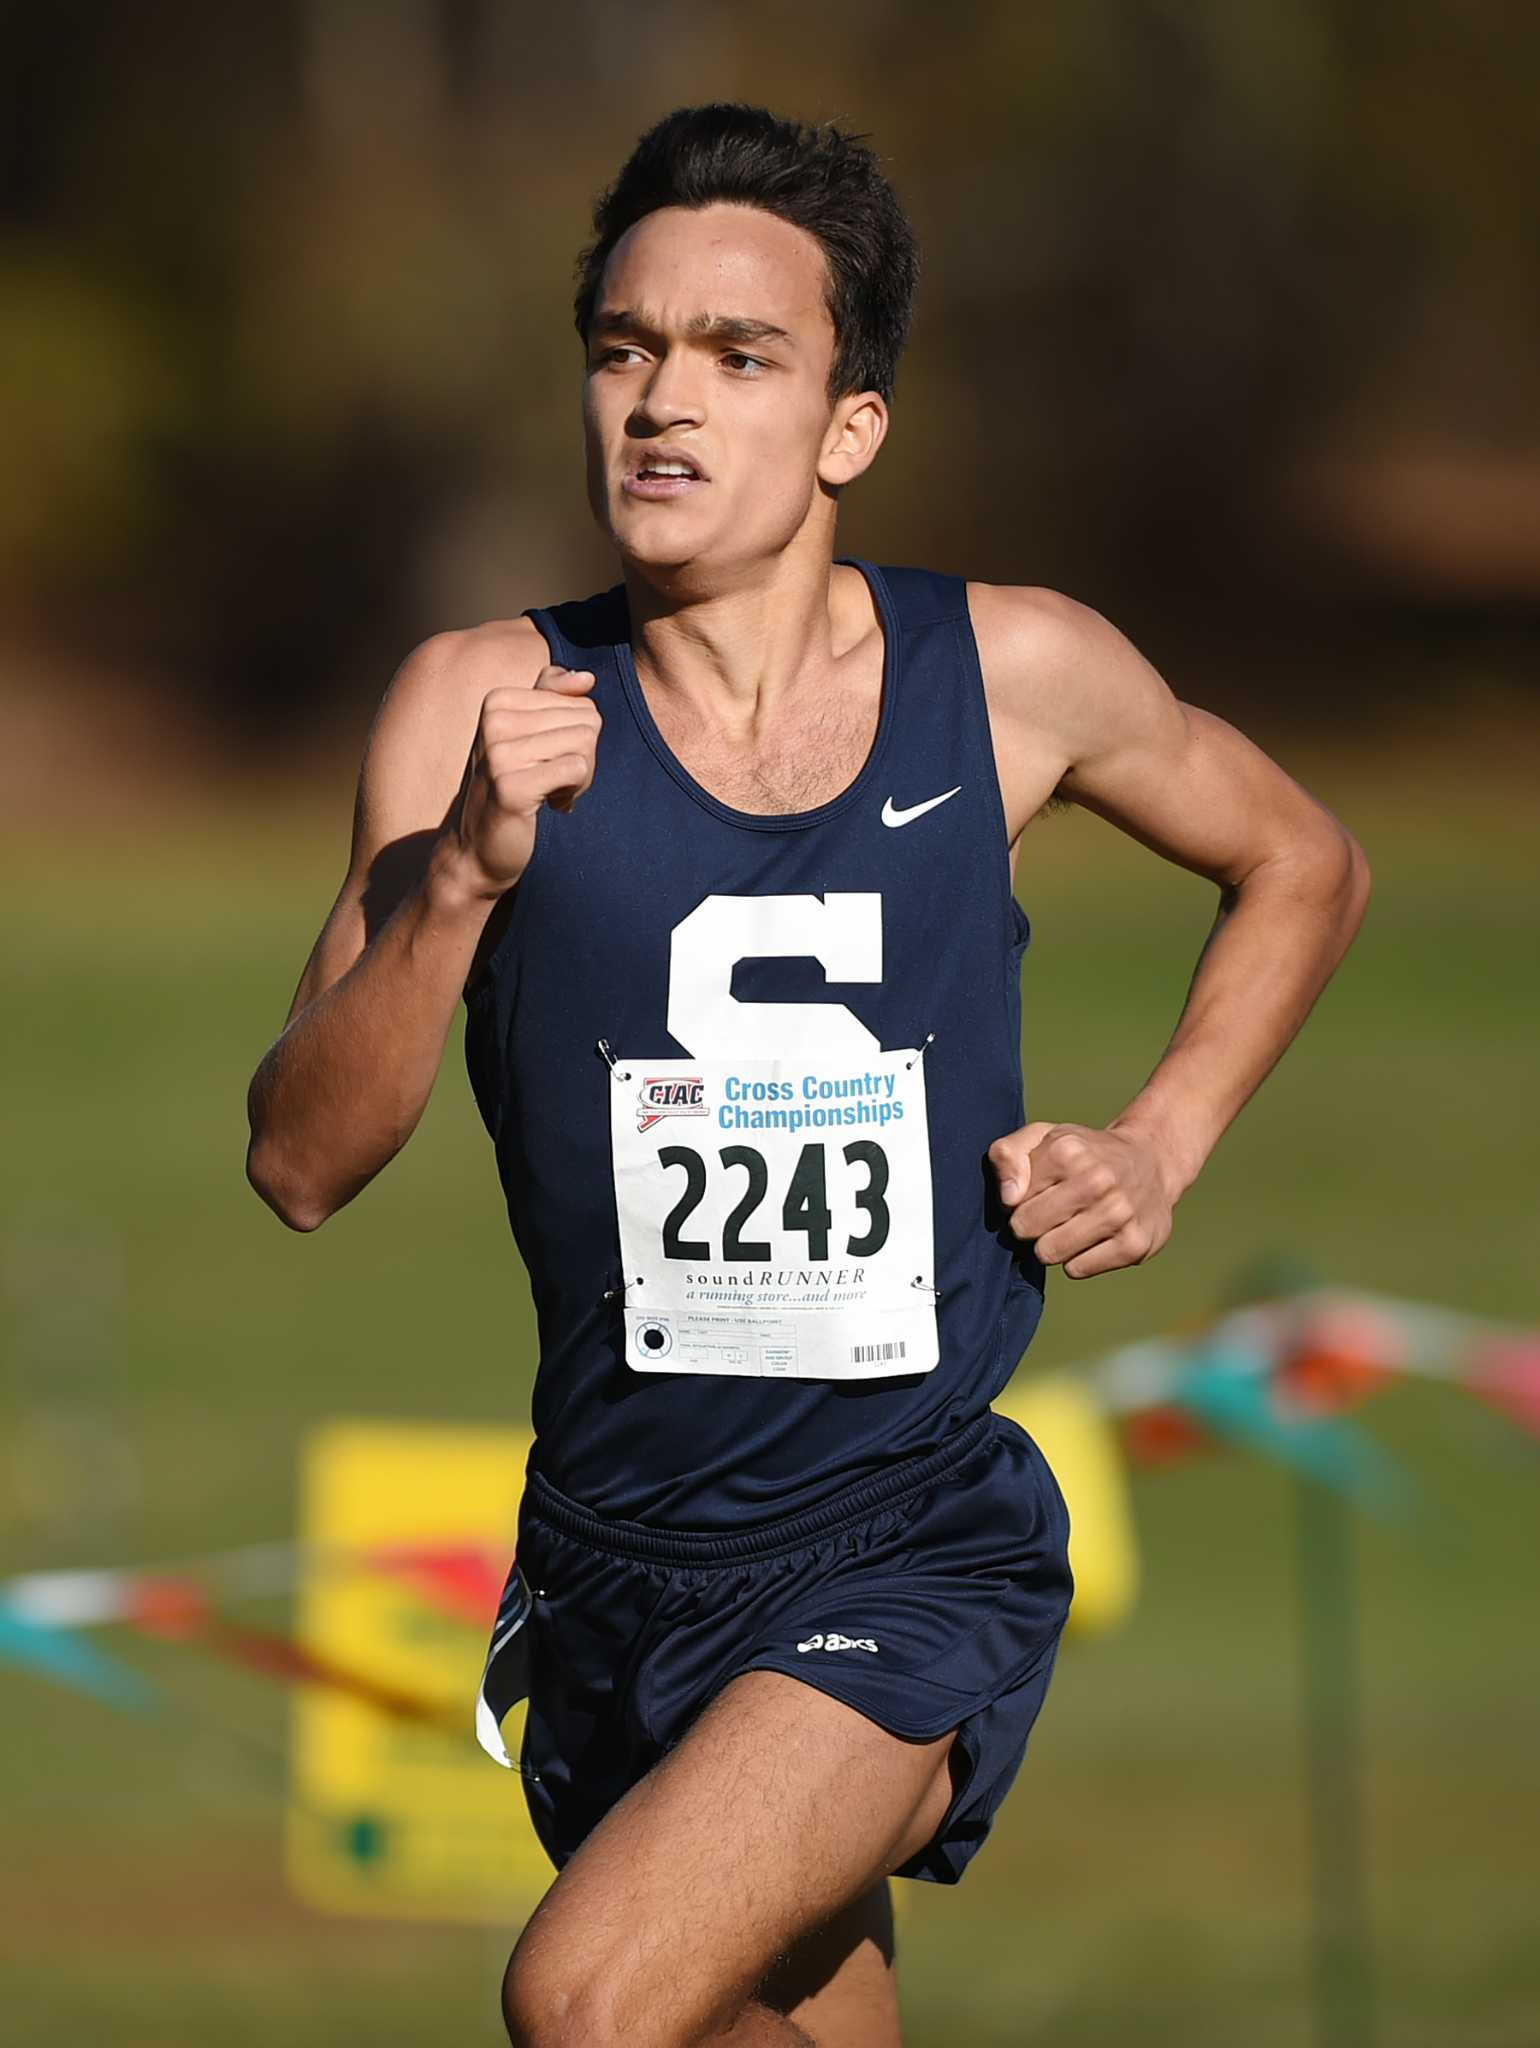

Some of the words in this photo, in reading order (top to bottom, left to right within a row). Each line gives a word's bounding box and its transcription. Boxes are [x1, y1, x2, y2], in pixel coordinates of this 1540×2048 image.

[649, 1084, 704, 1105] CIAC
[725, 1076, 793, 1101] Cross
[802, 1072, 895, 1100] Country
[718, 1100, 904, 1132] Championships
[657, 1140, 890, 1262] 2243
[686, 1290, 695, 1300] a
[699, 1289, 753, 1305] running
[833, 1290, 867, 1302] more
